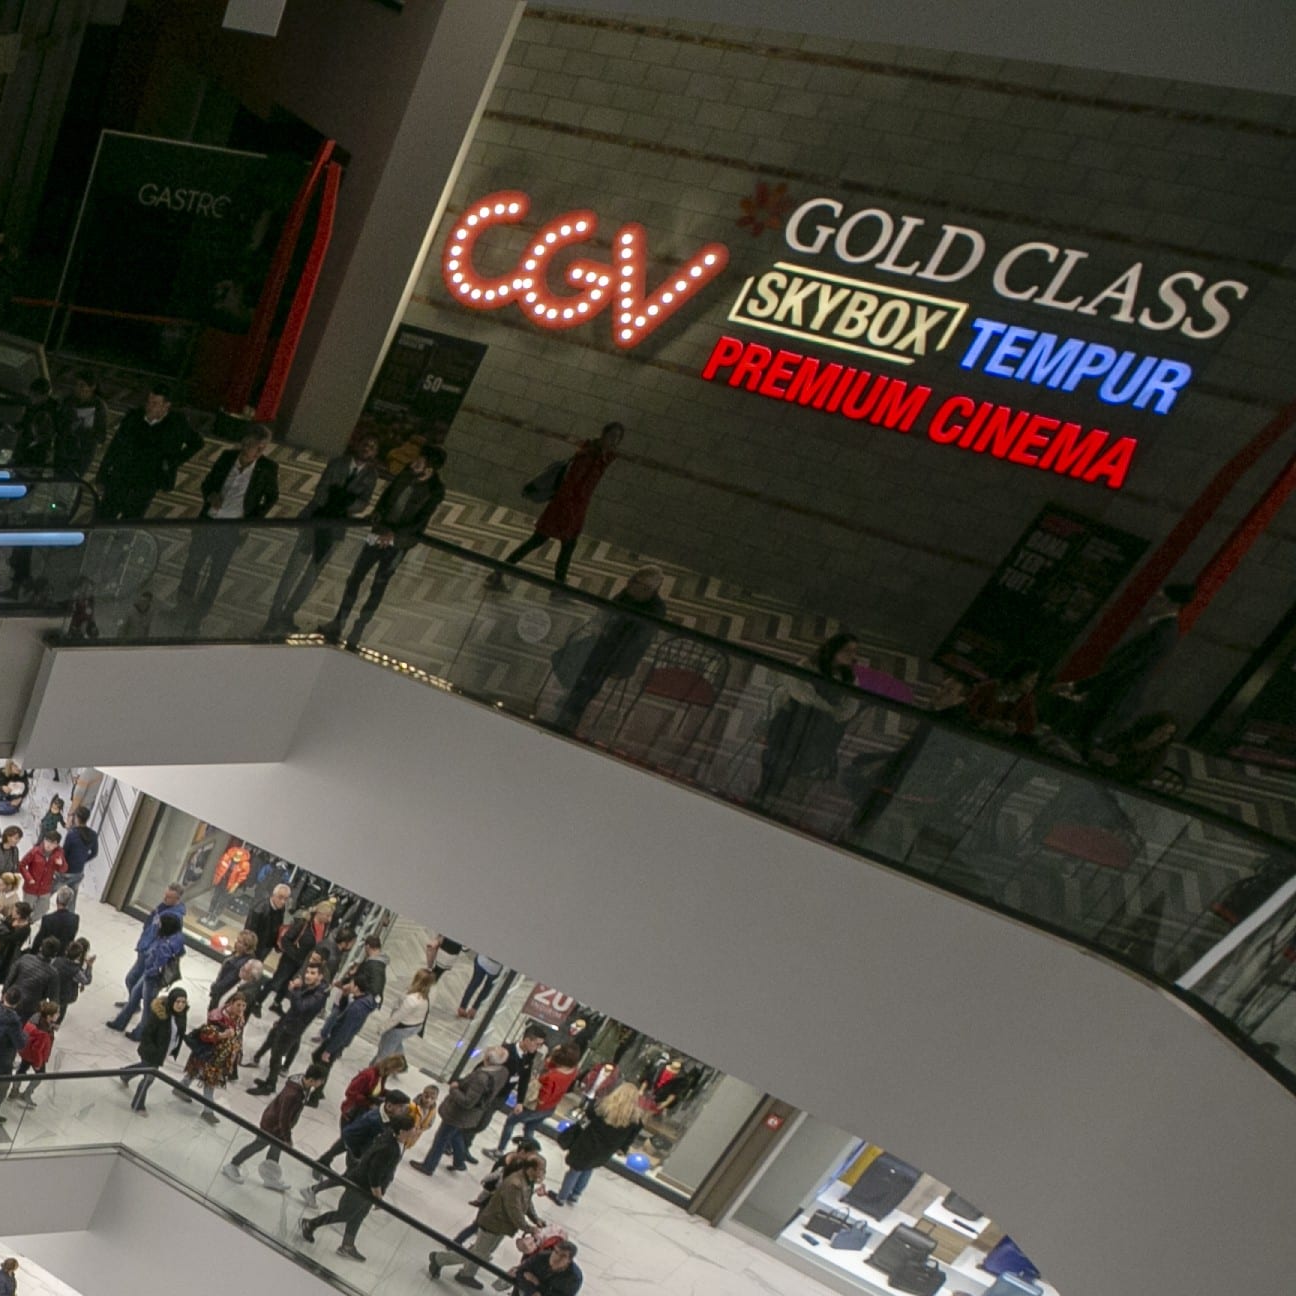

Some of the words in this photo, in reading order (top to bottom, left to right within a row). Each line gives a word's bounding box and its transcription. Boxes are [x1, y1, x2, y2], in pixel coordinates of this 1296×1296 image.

[442, 190, 728, 349] CGV
[746, 271, 949, 356] SKYBOX
[784, 197, 986, 284] GOLD
[991, 241, 1250, 340] CLASS
[701, 334, 933, 433] PREMIUM
[928, 394, 1138, 489] CINEMA
[959, 317, 1193, 415] TEMPUR
